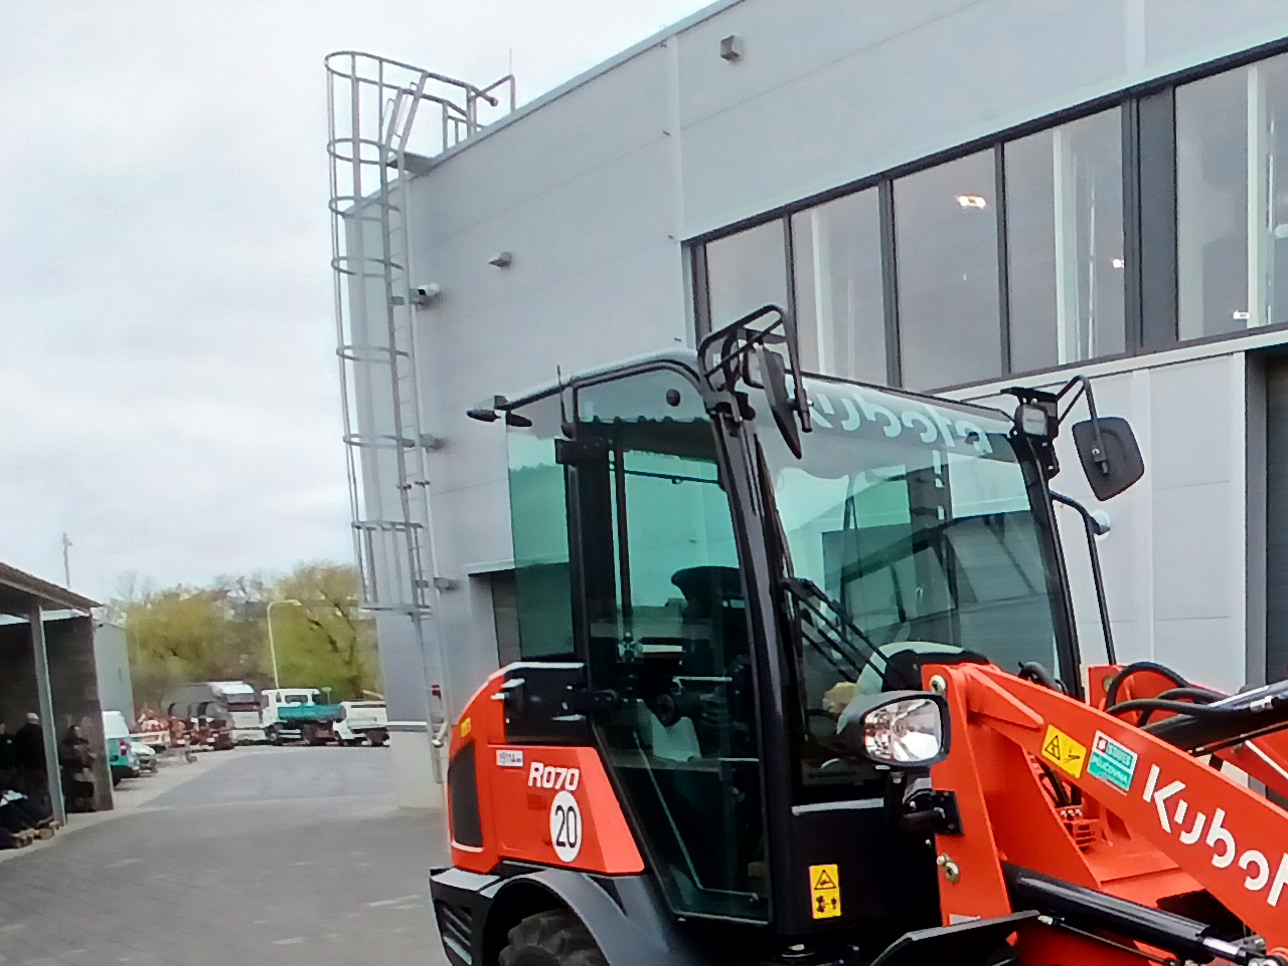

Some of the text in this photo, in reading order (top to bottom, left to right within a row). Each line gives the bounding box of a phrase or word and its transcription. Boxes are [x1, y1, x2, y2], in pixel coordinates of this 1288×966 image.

[810, 392, 993, 454] ubota
[528, 762, 580, 791] R070
[555, 804, 578, 849] 20
